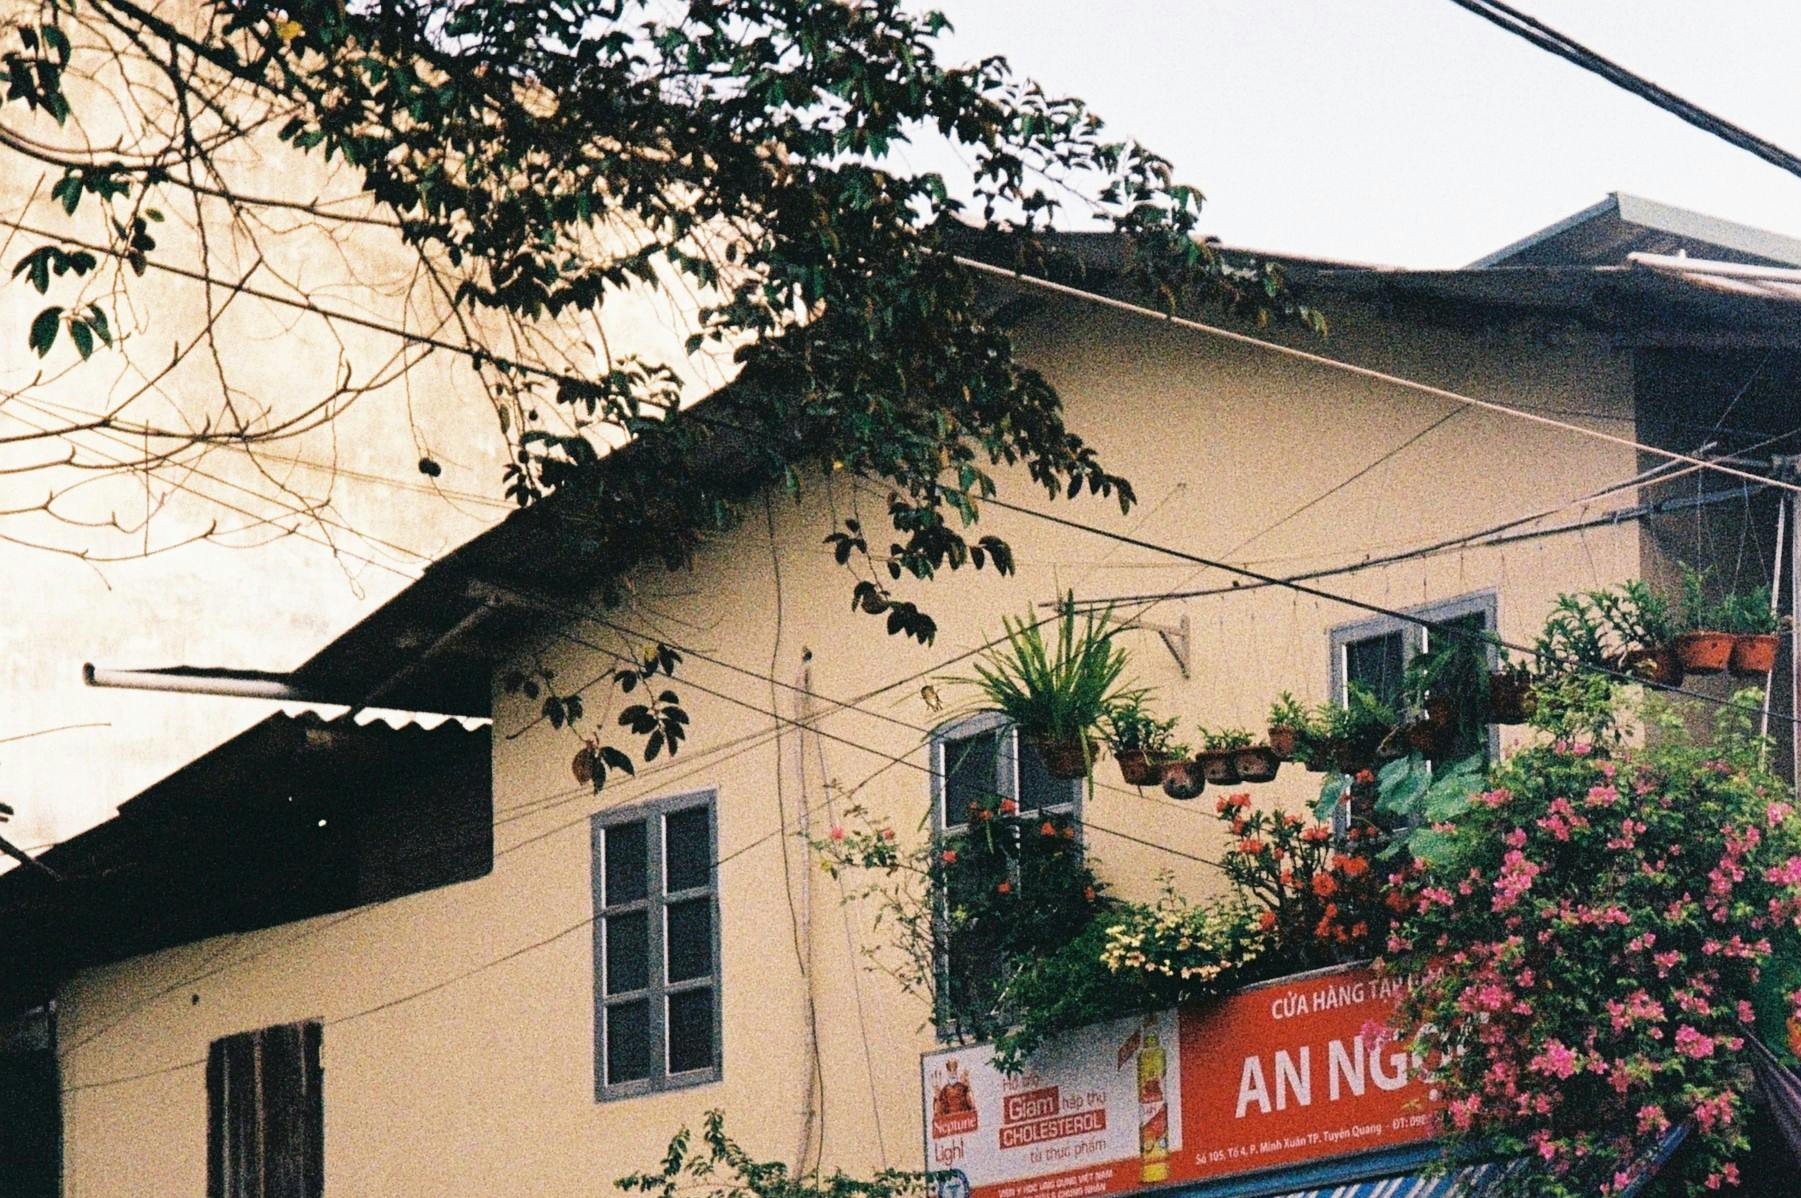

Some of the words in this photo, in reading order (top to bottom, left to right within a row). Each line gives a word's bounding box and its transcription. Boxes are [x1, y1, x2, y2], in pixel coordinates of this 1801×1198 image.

[1271, 991, 1309, 1020] CỬA
[1313, 983, 1365, 1013] HÀNG
[1235, 1046, 1312, 1119] AN
[1328, 1020, 1470, 1102] NGỌ
[933, 1115, 977, 1136] Neptune
[1003, 1112, 1103, 1147] CHOLESTEROL
[1260, 1138, 1283, 1154] Minh
[1323, 1128, 1351, 1146] Tuyên
[1352, 1122, 1383, 1142] Quang
[935, 1141, 964, 1166] Light
